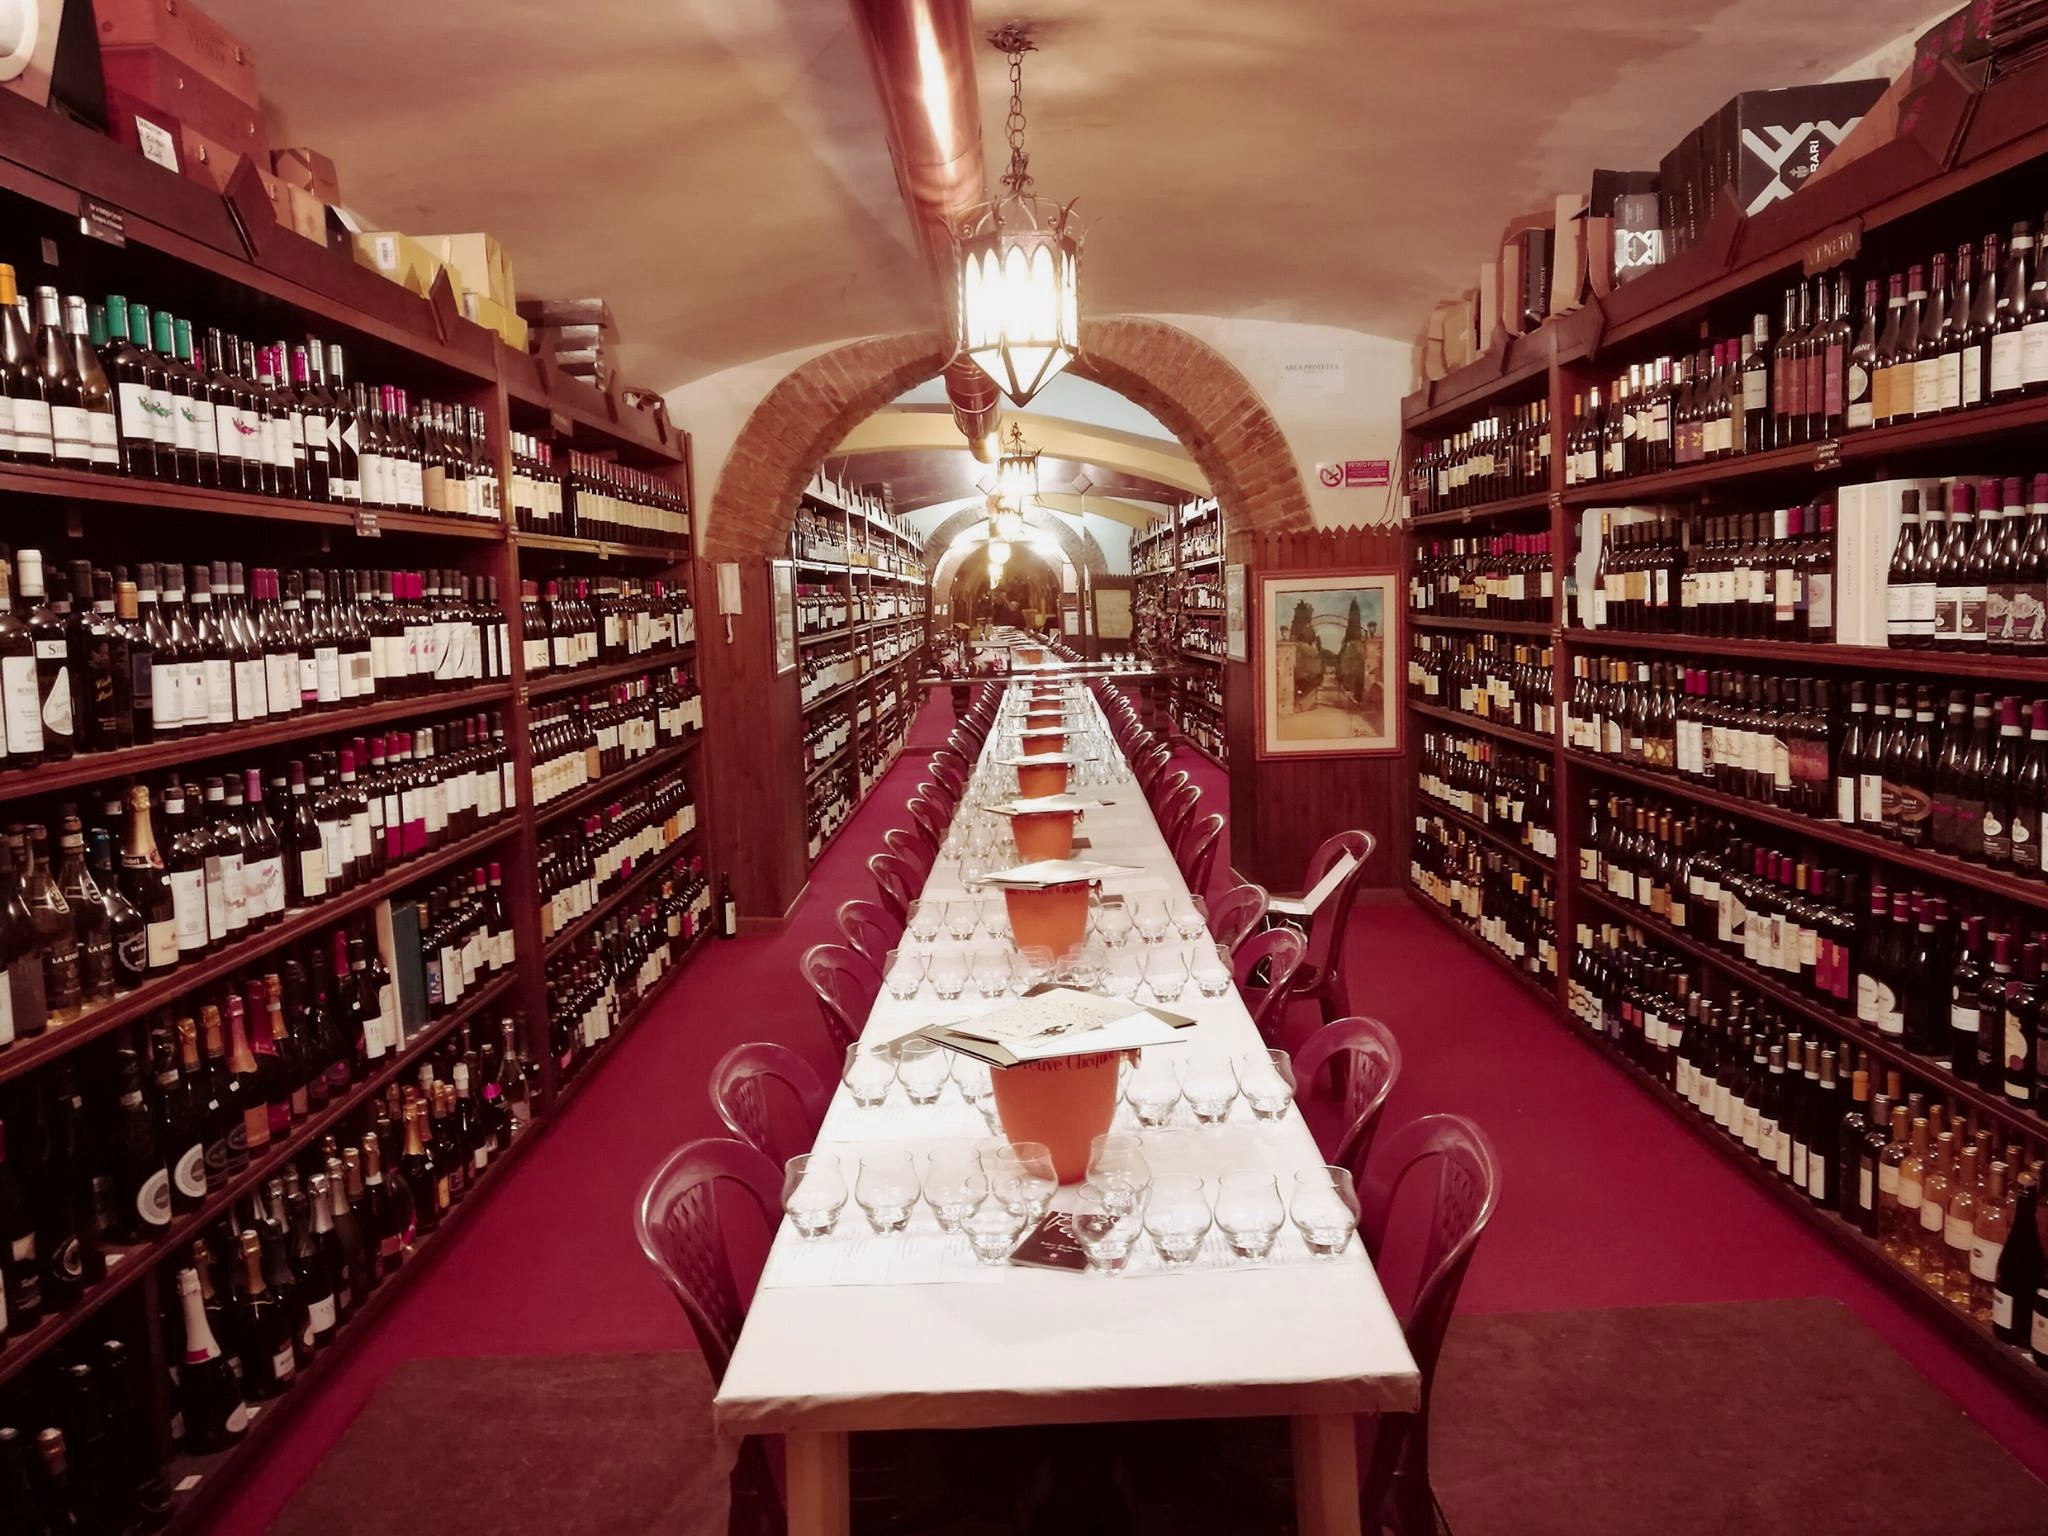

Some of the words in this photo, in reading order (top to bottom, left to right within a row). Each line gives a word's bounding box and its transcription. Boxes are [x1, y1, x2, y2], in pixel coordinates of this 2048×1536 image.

[1805, 231, 1854, 265] VENETO
[1285, 363, 1303, 371] AREA
[1303, 363, 1339, 371] PROTETTA
